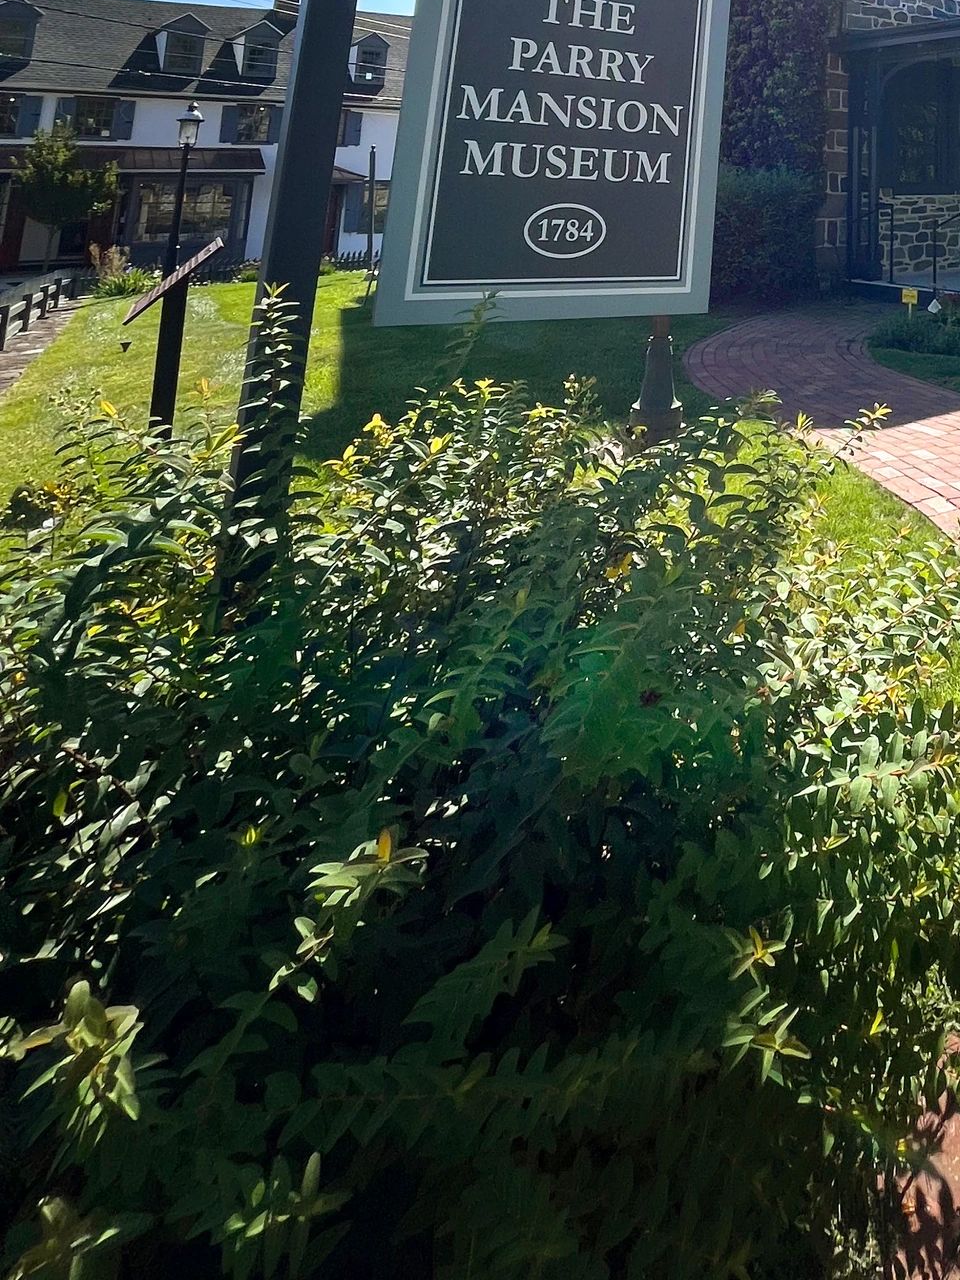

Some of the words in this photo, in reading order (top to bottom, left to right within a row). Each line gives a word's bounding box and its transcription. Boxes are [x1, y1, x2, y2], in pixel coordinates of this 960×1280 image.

[507, 36, 655, 85] PARRY
[456, 84, 684, 137] MANSION
[459, 139, 672, 184] MUSEUM
[537, 218, 594, 242] 1784
